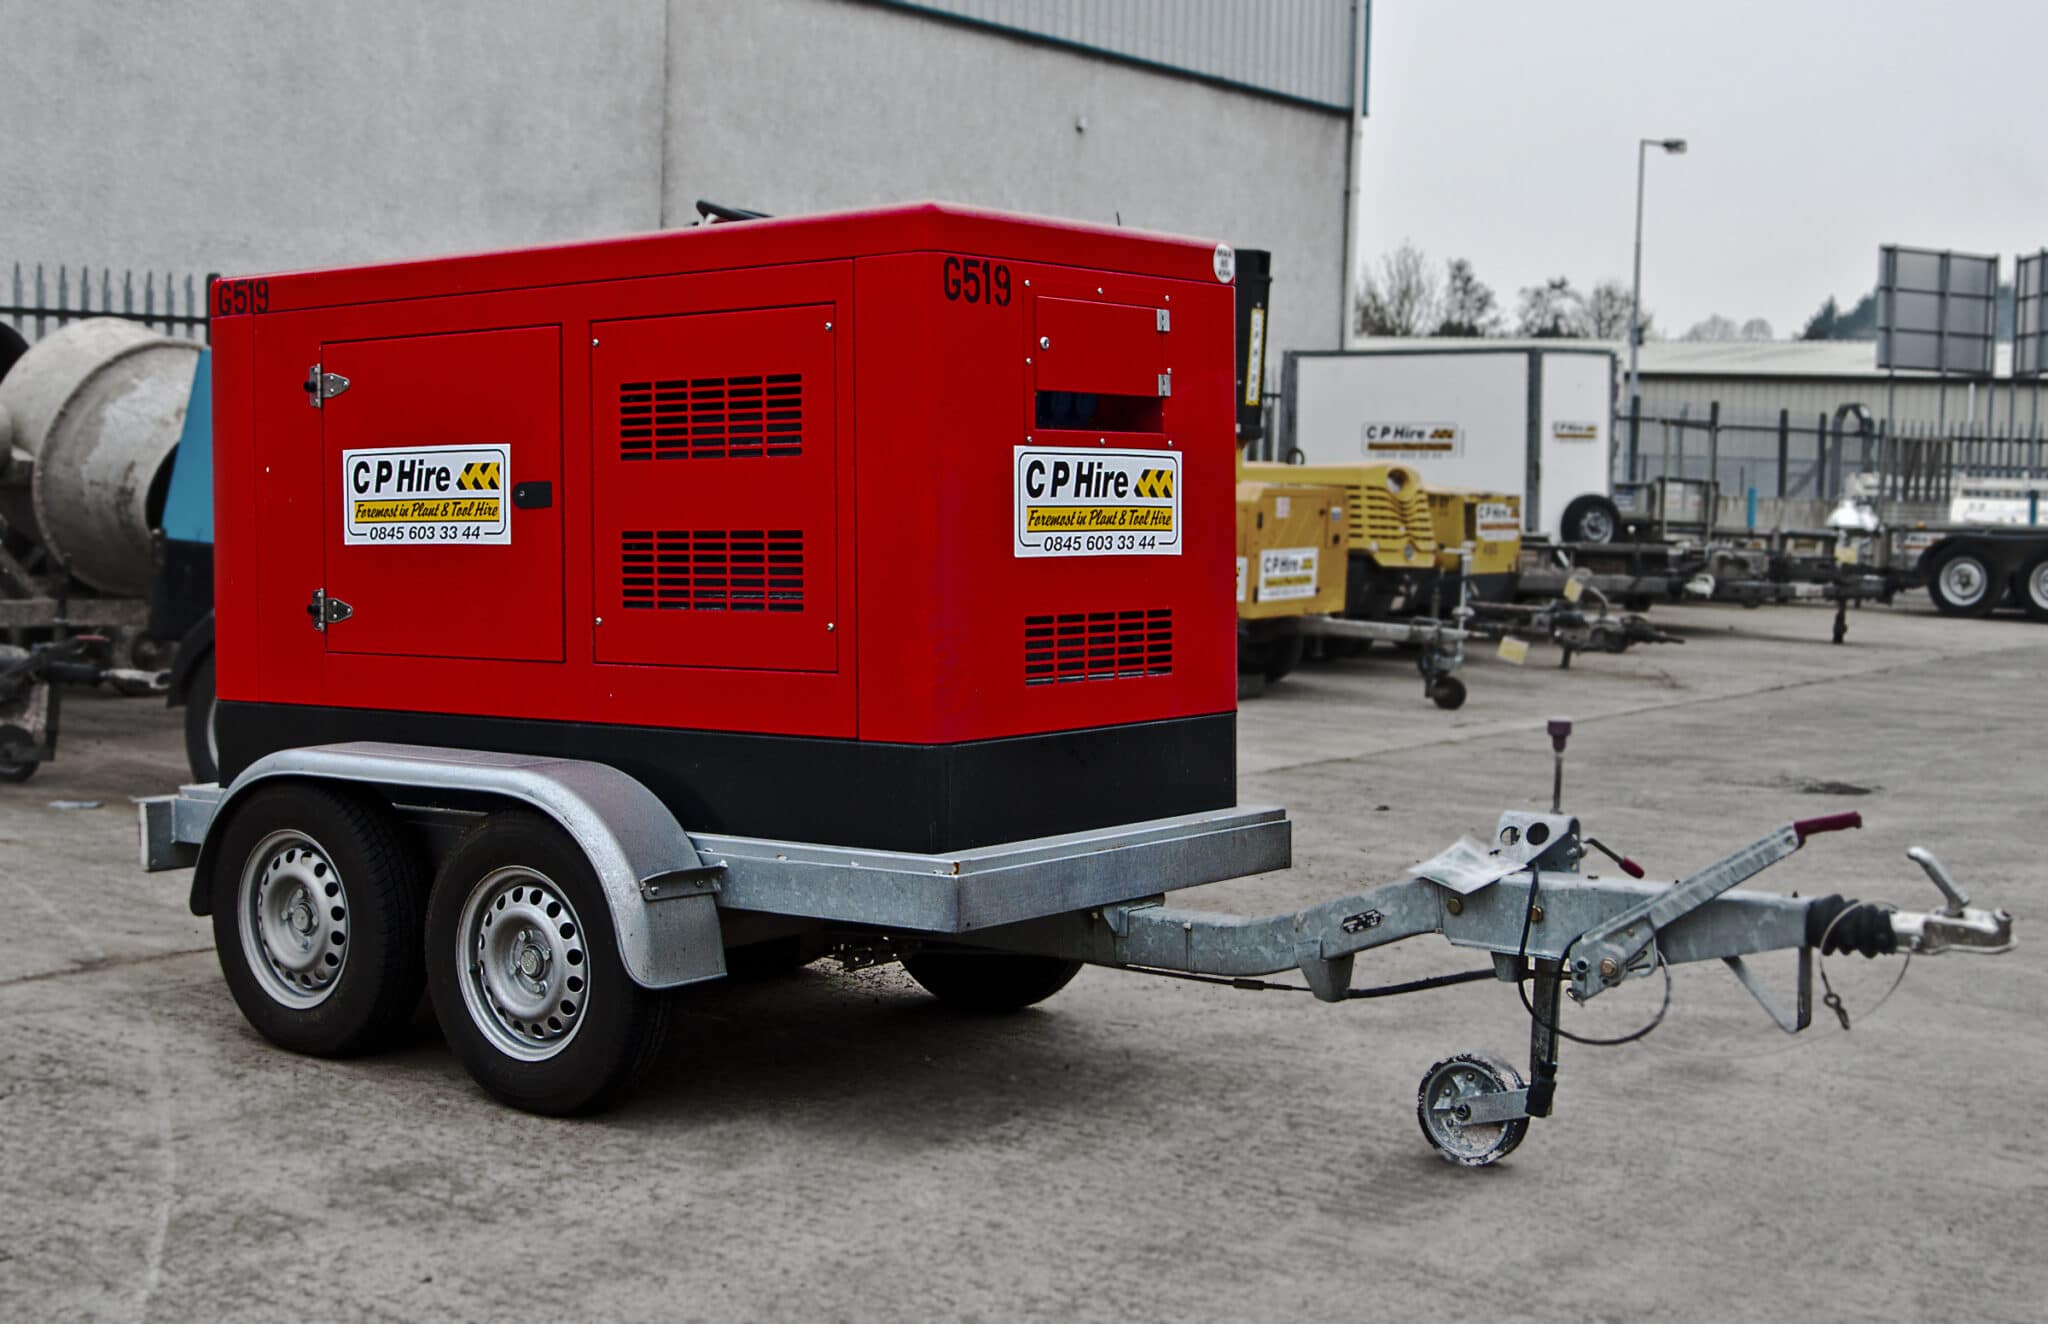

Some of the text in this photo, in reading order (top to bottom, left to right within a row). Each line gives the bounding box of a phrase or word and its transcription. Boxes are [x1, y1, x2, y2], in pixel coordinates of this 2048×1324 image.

[944, 256, 1011, 307] G519
[218, 279, 269, 316] G519
[1393, 425, 1425, 439] Hire
[396, 459, 450, 492] Hire
[1073, 461, 1129, 498] Hire
[355, 501, 498, 518] Foremost in Plant & Tool Hire
[1028, 509, 1172, 527] Foremost in Plant & Tool Hire
[369, 525, 481, 540] 0845 603 33 44
[1044, 535, 1156, 551] 0845 603 33 44
